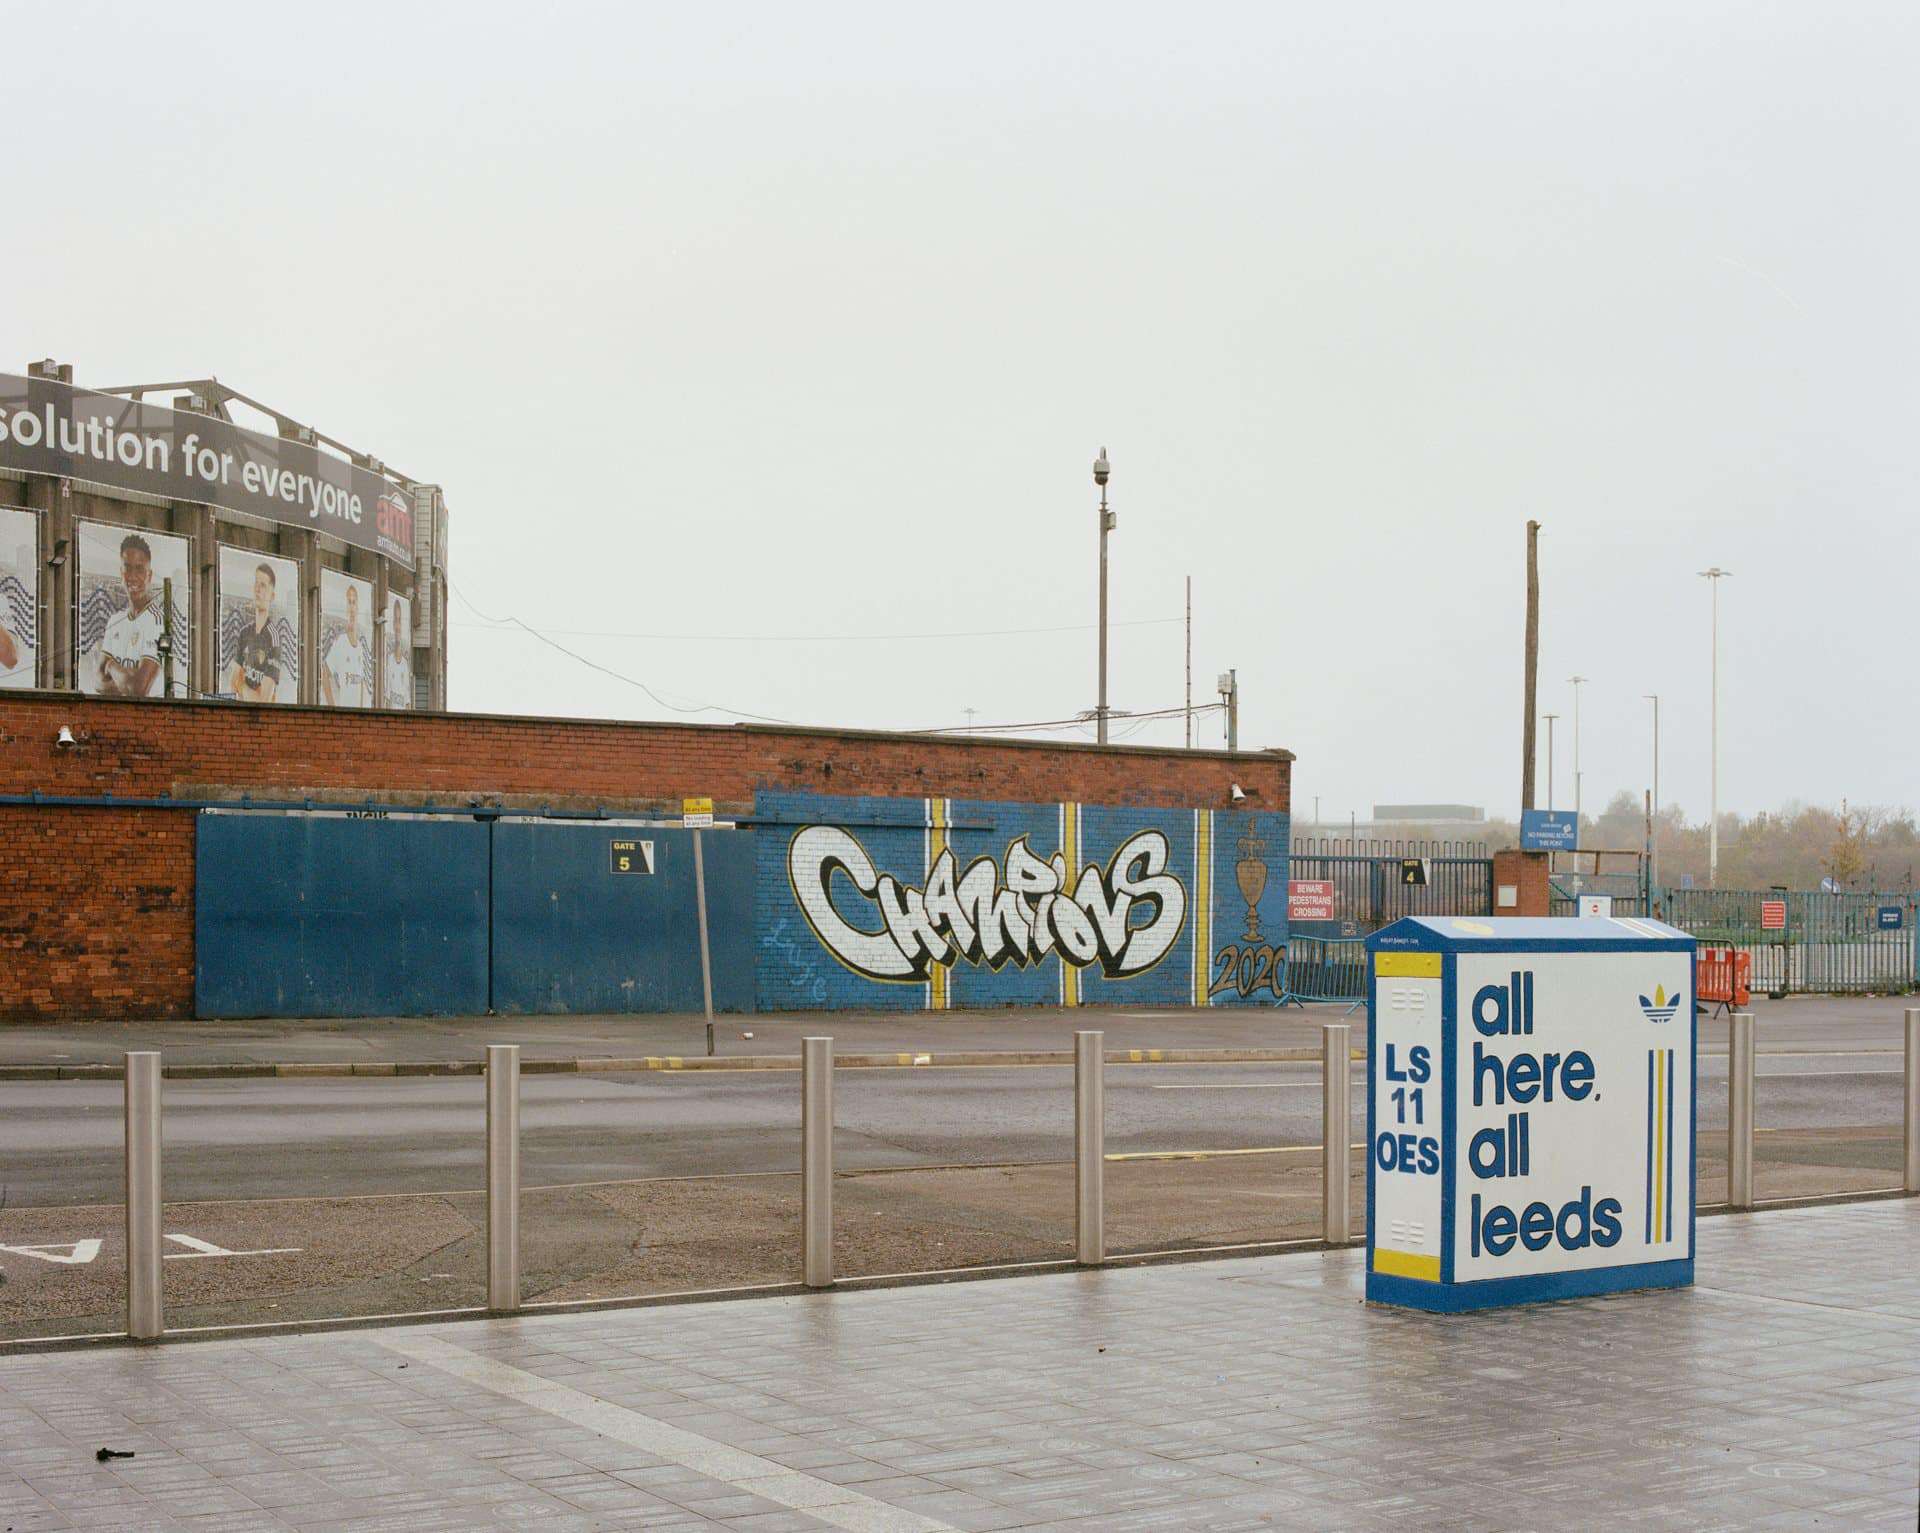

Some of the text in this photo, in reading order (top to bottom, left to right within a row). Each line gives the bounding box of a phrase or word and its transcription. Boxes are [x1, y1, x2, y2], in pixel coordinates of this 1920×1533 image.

[182, 433, 233, 484] for
[242, 461, 362, 524] everyone
[613, 842, 635, 850] GATE
[619, 857, 630, 871] 5
[1297, 884, 1323, 893] BEWARE
[1407, 872, 1414, 882] 4
[1288, 895, 1331, 905] PEDESTRIANS
[1293, 907, 1327, 917] CROSSING
[1472, 971, 1533, 1036] all
[1386, 1043, 1431, 1083] LS
[1391, 1087, 1423, 1124] 11
[1469, 1112, 1529, 1179] all
[1471, 1186, 1622, 1257] leeds
